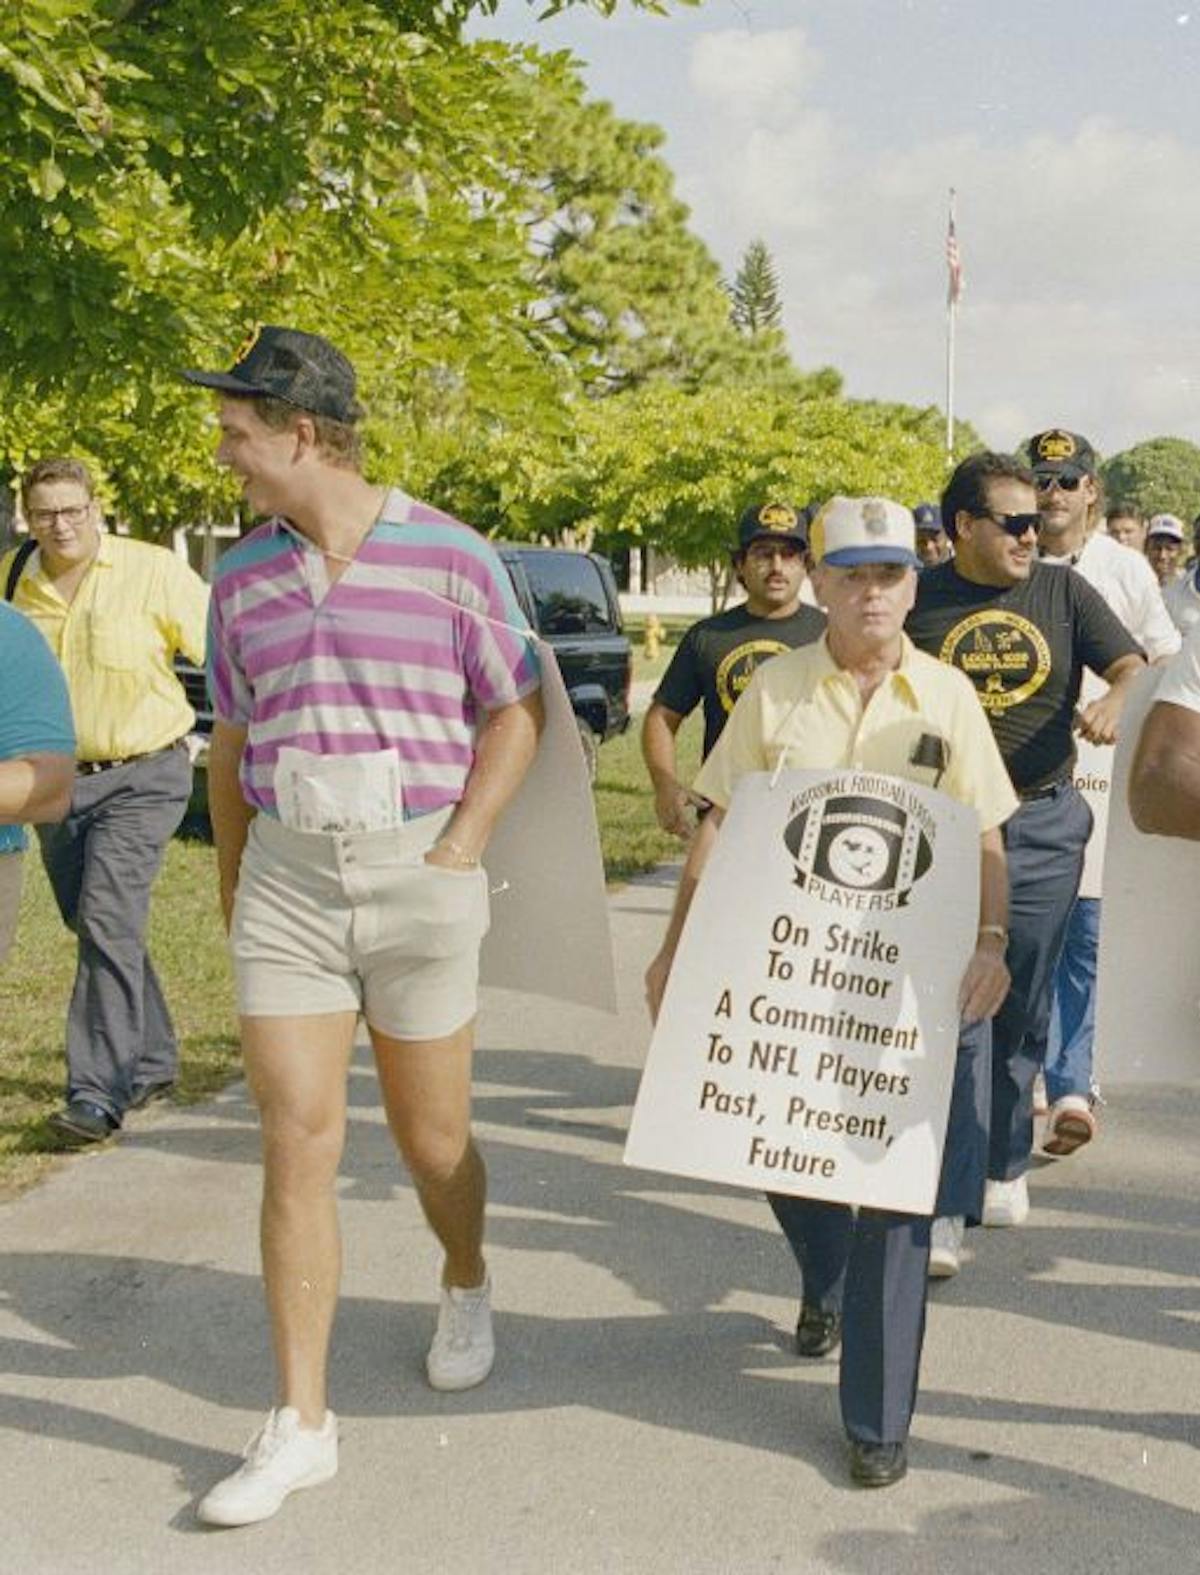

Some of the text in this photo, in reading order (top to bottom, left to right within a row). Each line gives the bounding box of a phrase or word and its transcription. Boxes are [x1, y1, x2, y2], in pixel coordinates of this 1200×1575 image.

[808, 878, 894, 910] PLAYERS
[771, 915, 900, 965] On Strike
[767, 950, 893, 1000] To Honor
[714, 989, 919, 1051] A Commitment
[706, 1034, 911, 1097] To NFL Players
[700, 1081, 897, 1147] Past, Present,
[748, 1137, 837, 1179] Future
